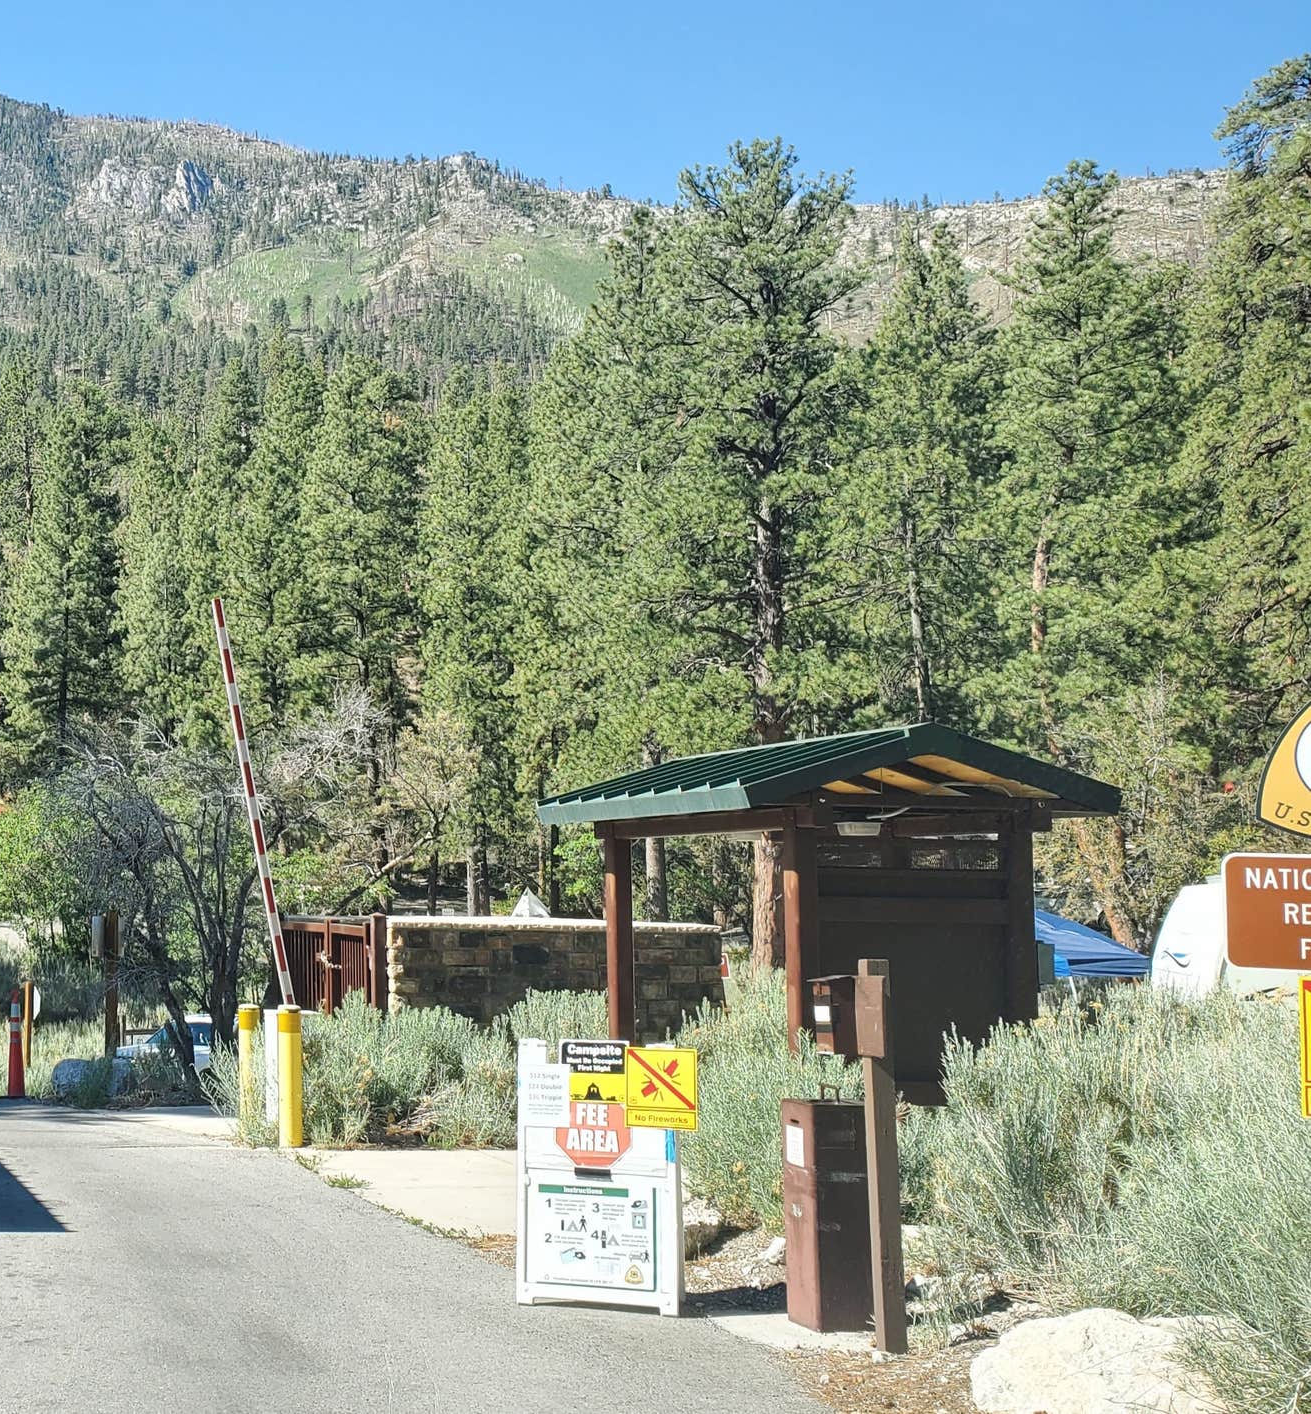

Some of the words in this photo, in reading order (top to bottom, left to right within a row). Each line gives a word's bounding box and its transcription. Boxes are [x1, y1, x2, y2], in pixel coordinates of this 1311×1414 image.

[567, 1043, 622, 1058] Campsite
[576, 1103, 609, 1126] FEE
[634, 1114, 647, 1122] No
[648, 1114, 689, 1124] Fireworks
[566, 1128, 619, 1153] AREA
[563, 1186, 603, 1195] Instructions
[545, 1198, 552, 1208] 1
[592, 1202, 600, 1213] 3
[544, 1232, 553, 1243] 2
[590, 1230, 600, 1241] 4
